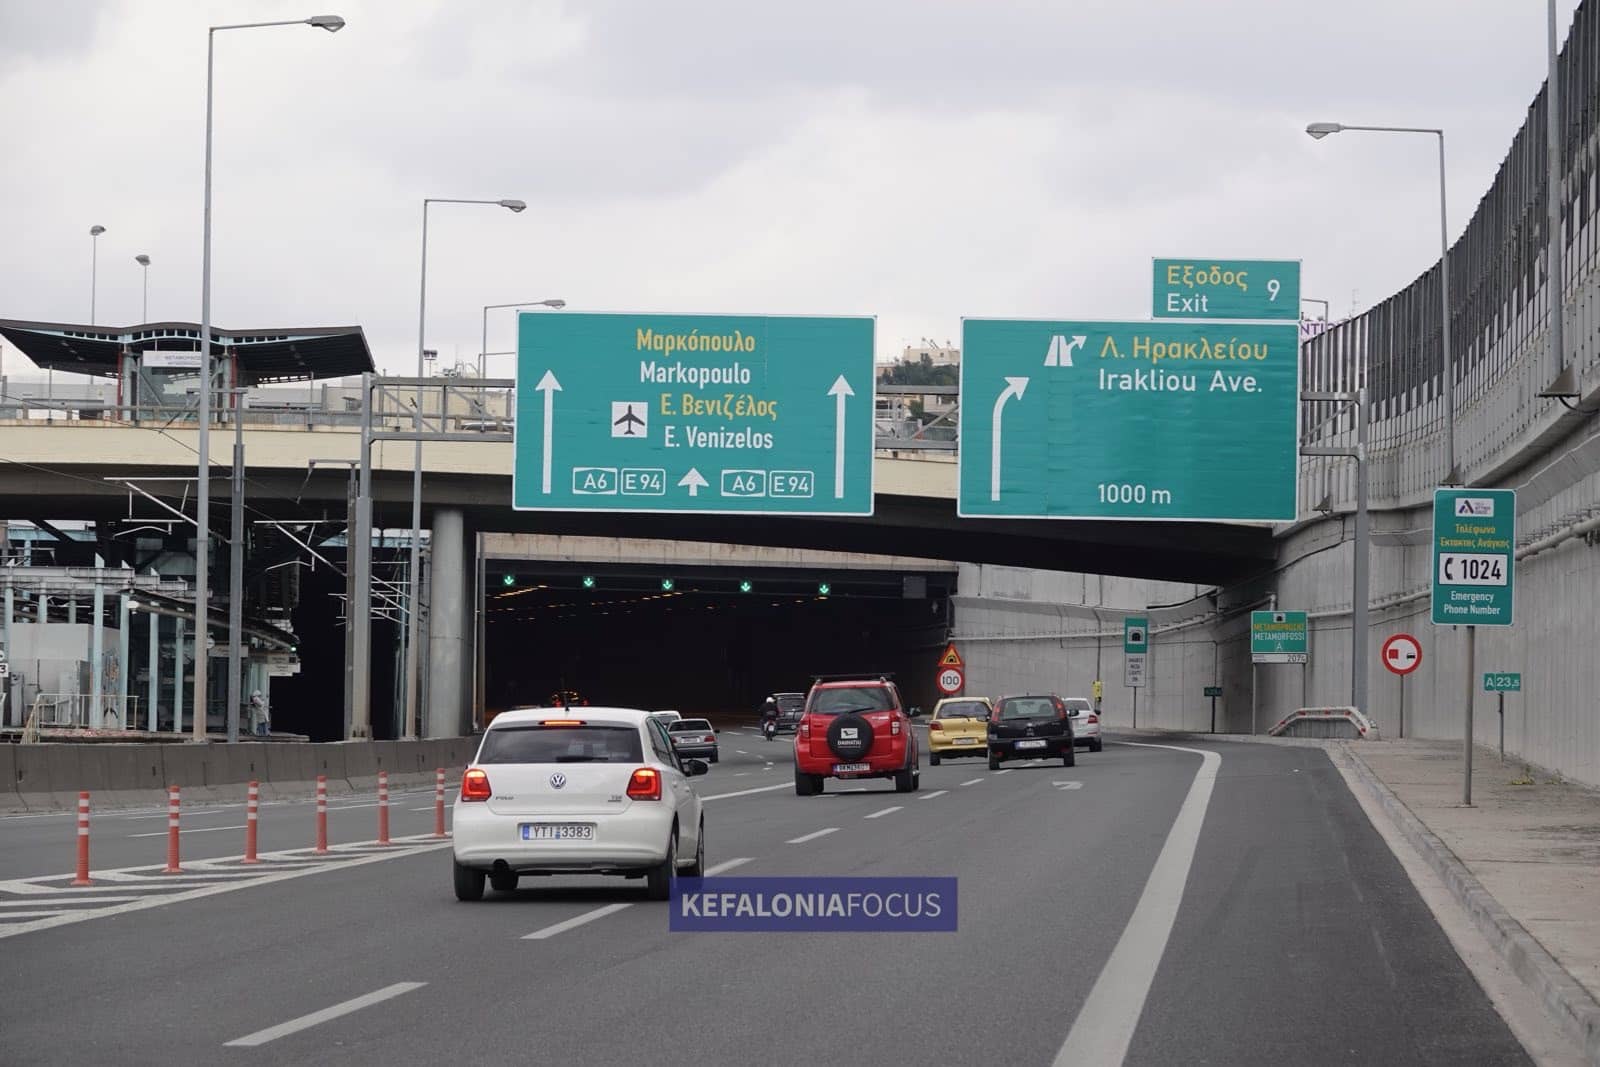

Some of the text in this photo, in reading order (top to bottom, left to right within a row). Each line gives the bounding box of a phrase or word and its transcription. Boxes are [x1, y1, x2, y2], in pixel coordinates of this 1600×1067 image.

[1167, 266, 1248, 291] Εξοδος
[1267, 279, 1280, 301] 9
[1167, 293, 1208, 313] Exit
[636, 328, 755, 356] Μαρκόπουλο
[1100, 336, 1268, 364] Λ. Ηρακλείου
[640, 361, 750, 389] Markopoulo
[1099, 369, 1263, 393] Irakliou Ave.
[660, 394, 778, 421] Ε. Βενιζέλος
[664, 426, 774, 449] E. Venizelos
[583, 473, 608, 489] A6
[732, 475, 756, 492] A6
[1098, 484, 1171, 504] 1000 m
[1461, 559, 1501, 580] 1024
[1451, 590, 1494, 603] Emergency
[1443, 604, 1501, 615] Phone Number
[940, 674, 960, 687] 100
[1486, 677, 1494, 687] A
[561, 826, 592, 838] 3383
